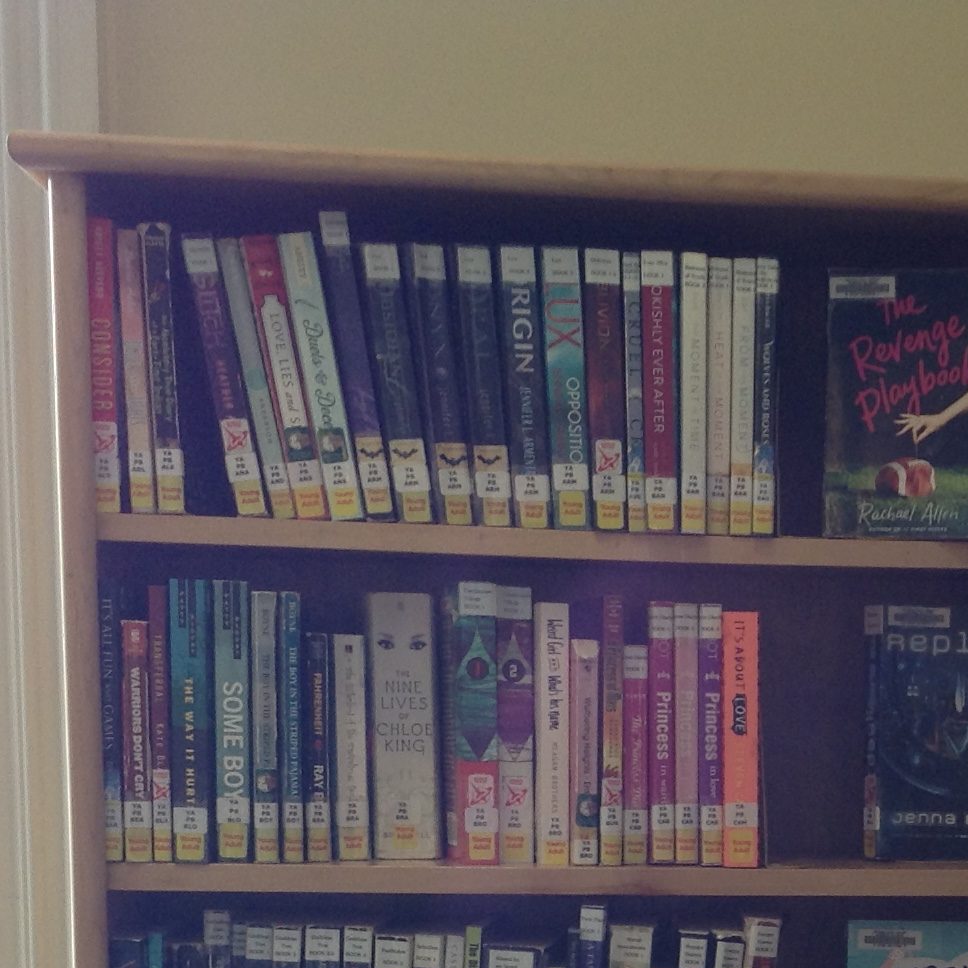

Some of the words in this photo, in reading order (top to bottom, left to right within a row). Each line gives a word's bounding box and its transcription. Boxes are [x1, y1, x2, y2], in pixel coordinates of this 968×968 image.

[876, 294, 928, 326] The
[268, 313, 289, 354] LOVE,
[511, 287, 534, 373] RIGIN
[850, 314, 966, 381] Revenge
[91, 319, 113, 410] CONSIDER
[279, 359, 293, 388] LIES
[652, 349, 663, 385] EVER
[284, 392, 298, 412] and
[652, 389, 664, 433] AFTER
[565, 376, 583, 463] OPPOSITIO
[857, 500, 917, 524] Rachael
[734, 620, 744, 644] IT'S
[288, 647, 297, 665] THE
[184, 677, 194, 704] THE
[289, 666, 297, 685] BOY
[384, 679, 423, 694] NINE
[130, 667, 143, 733] WARRIORS
[223, 681, 243, 749] SOME
[289, 700, 298, 718] THE
[313, 673, 323, 736] FAHRENHEIT
[380, 696, 428, 710] LIVES
[735, 697, 746, 732] LOVE
[184, 711, 194, 741] WAY
[289, 720, 298, 759] STRIPED
[376, 723, 432, 737] CHLOE
[656, 692, 671, 760] Princess
[704, 692, 720, 761] Princess
[132, 735, 144, 772] DON'T
[185, 749, 195, 761] IT
[384, 739, 425, 755] KING
[135, 774, 145, 799] CRY
[185, 768, 195, 807] HURT
[223, 756, 244, 799] BOY
[313, 765, 324, 790] RAY
[892, 811, 957, 826] Jenna
[466, 943, 479, 958] The
